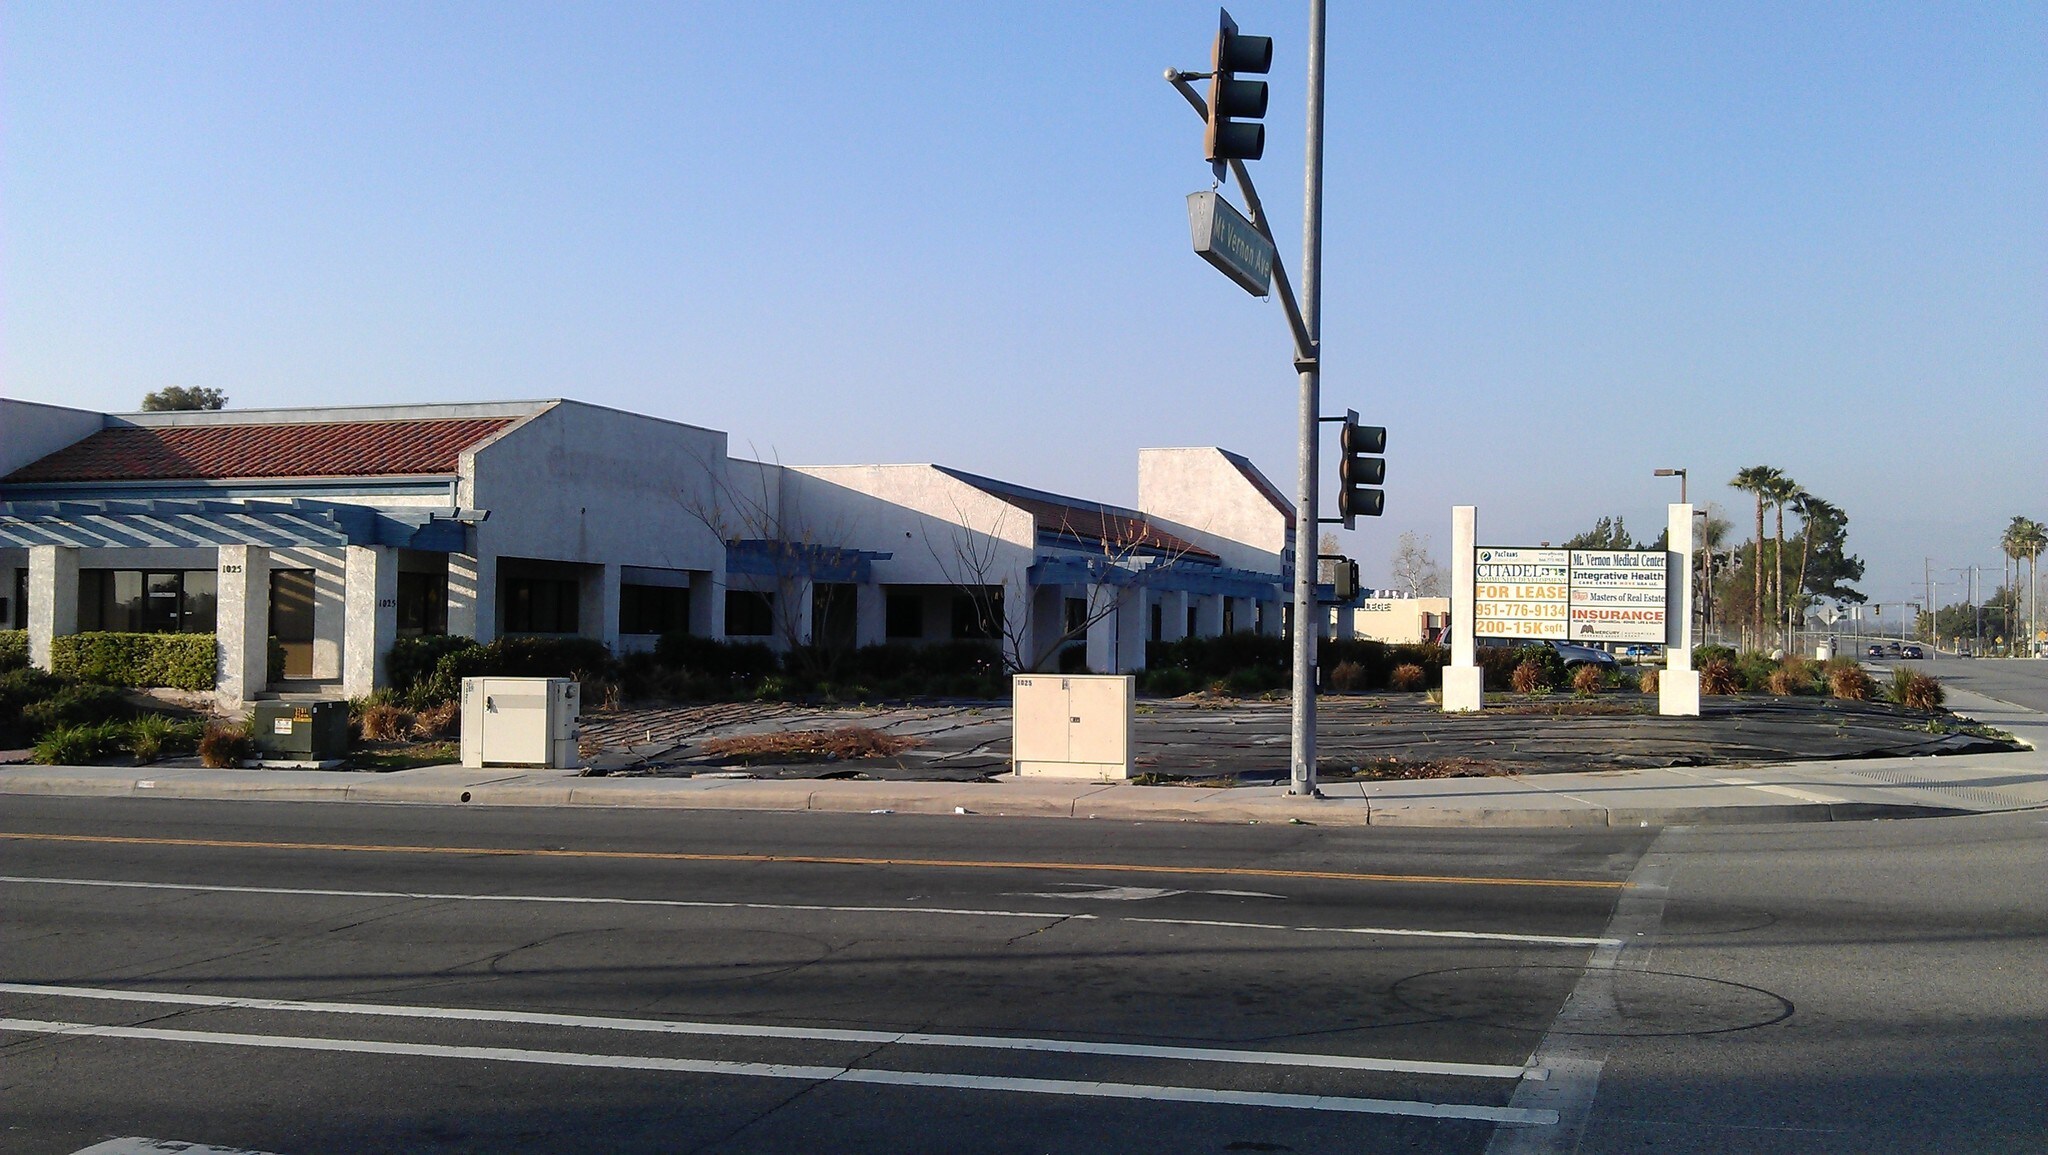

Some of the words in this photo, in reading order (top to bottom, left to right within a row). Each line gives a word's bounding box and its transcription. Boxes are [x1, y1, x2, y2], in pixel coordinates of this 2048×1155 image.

[1213, 212, 1225, 243] Mt
[1227, 223, 1254, 266] Vernon
[1255, 250, 1269, 278] Ave
[1573, 553, 1584, 566] Mt.
[1586, 553, 1611, 566] Vernon
[1612, 553, 1639, 567] Medical
[1641, 554, 1665, 567] Center
[222, 564, 242, 573] 1025
[1477, 565, 1542, 577] CITADEL
[1573, 571, 1628, 581] Integrative
[1630, 572, 1664, 581] Health
[1476, 585, 1509, 598] FOR
[1515, 586, 1567, 599] LEASE
[1590, 592, 1617, 602] Masters
[1618, 593, 1626, 602] of
[1627, 593, 1642, 602] Real
[1643, 593, 1665, 603] Estate
[379, 599, 396, 608] 1025
[1476, 603, 1566, 617] 951-776-9134
[1572, 609, 1664, 621] INSURANCE
[1476, 621, 1543, 635] 200-15K
[1544, 624, 1566, 635] sqft.
